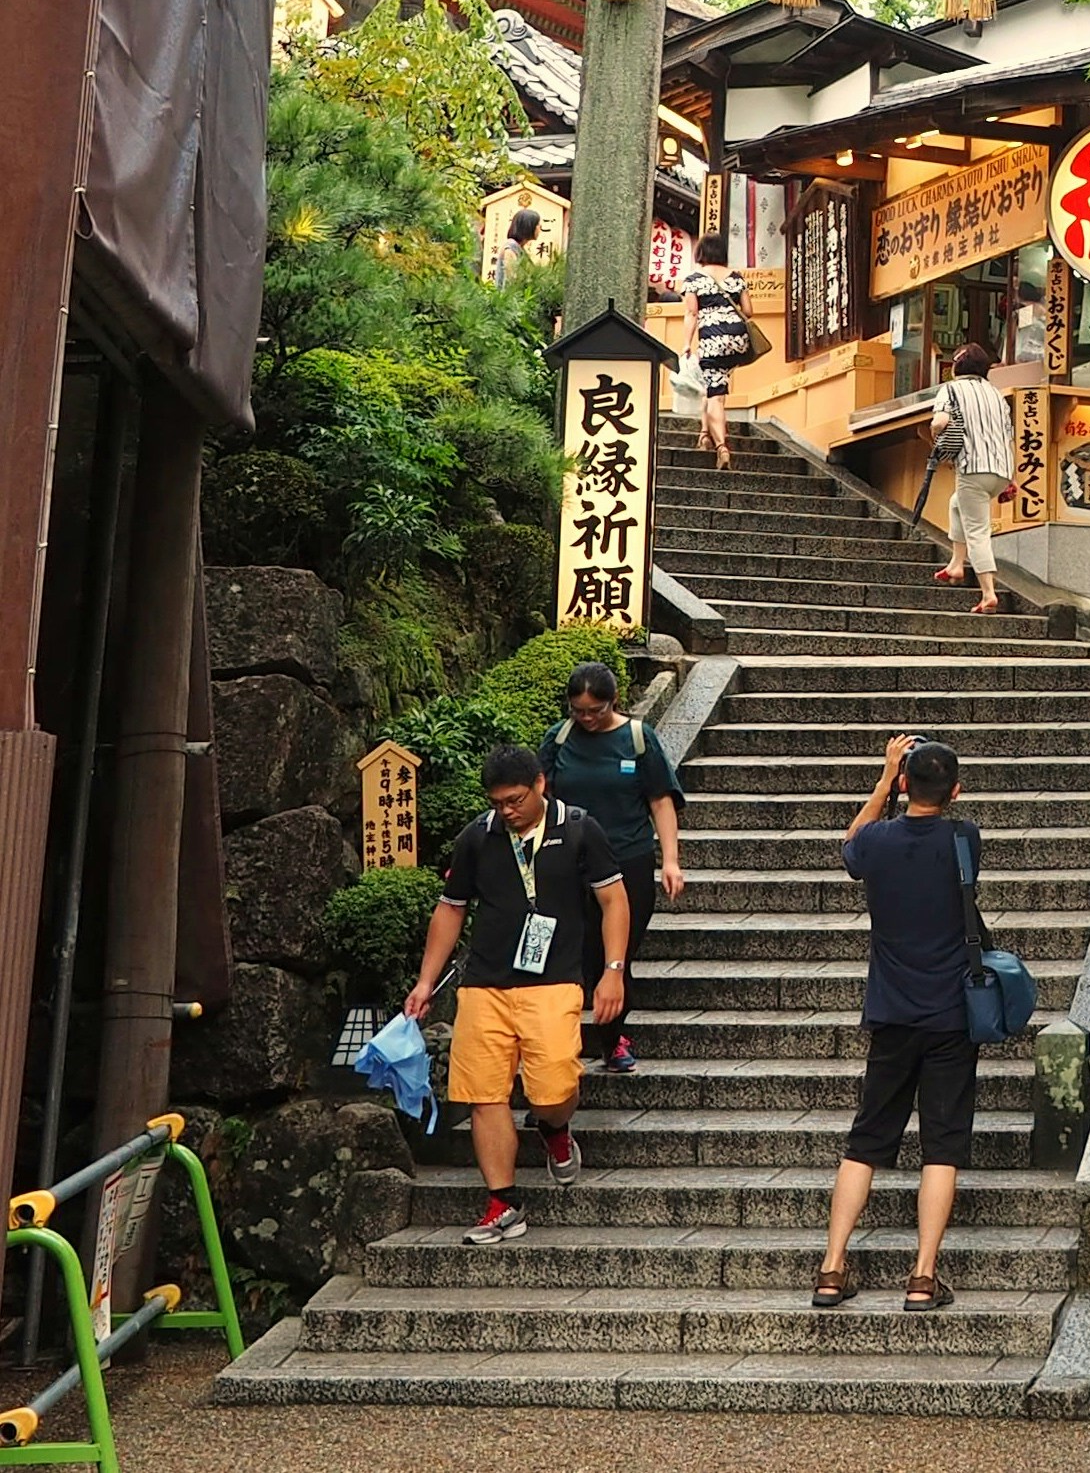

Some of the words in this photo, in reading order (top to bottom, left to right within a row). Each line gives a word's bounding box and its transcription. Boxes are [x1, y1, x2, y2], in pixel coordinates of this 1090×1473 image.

[875, 206, 896, 227] GOOD
[898, 196, 917, 218] LUCK
[920, 180, 954, 208] CHARMS
[956, 167, 983, 193] KYOTO
[1012, 145, 1043, 169] SHRINE
[875, 207, 941, 267] 恋のお守り
[945, 164, 1043, 237] 縁結びお守り
[1046, 261, 1065, 371] 恋占いおみくじ
[565, 373, 640, 624] 良縁祈願
[1018, 391, 1045, 518] 恋占いおみくじ
[396, 765, 414, 853] 参拝時間
